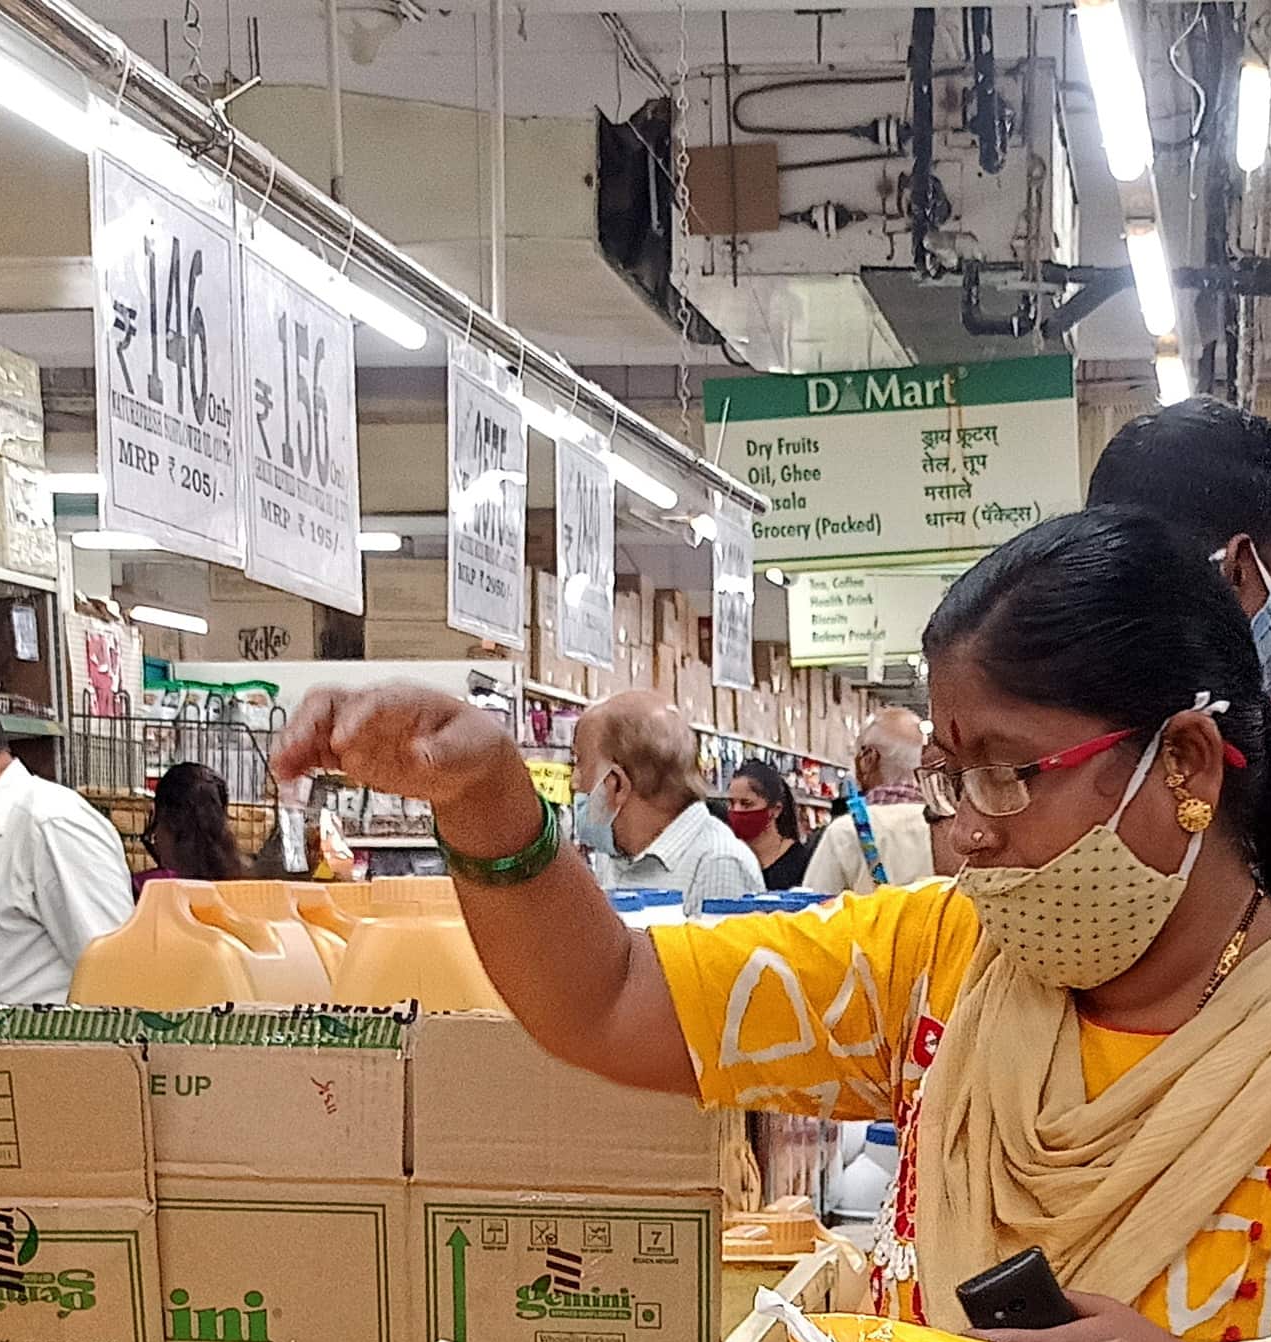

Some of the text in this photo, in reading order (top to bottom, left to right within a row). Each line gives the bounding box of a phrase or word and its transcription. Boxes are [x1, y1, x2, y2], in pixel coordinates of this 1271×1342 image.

[746, 435, 820, 459] Dry Fruits
[118, 437, 160, 476] MRP
[180, 464, 225, 505] 205/-
[747, 464, 822, 487] Oil, Ghee
[259, 496, 291, 530] MRP
[770, 493, 807, 511] sala
[752, 513, 882, 542] Grocery (Packed)
[175, 1075, 212, 1097] UP
[650, 1230, 663, 1246] 7
[515, 1286, 634, 1321] gemini
